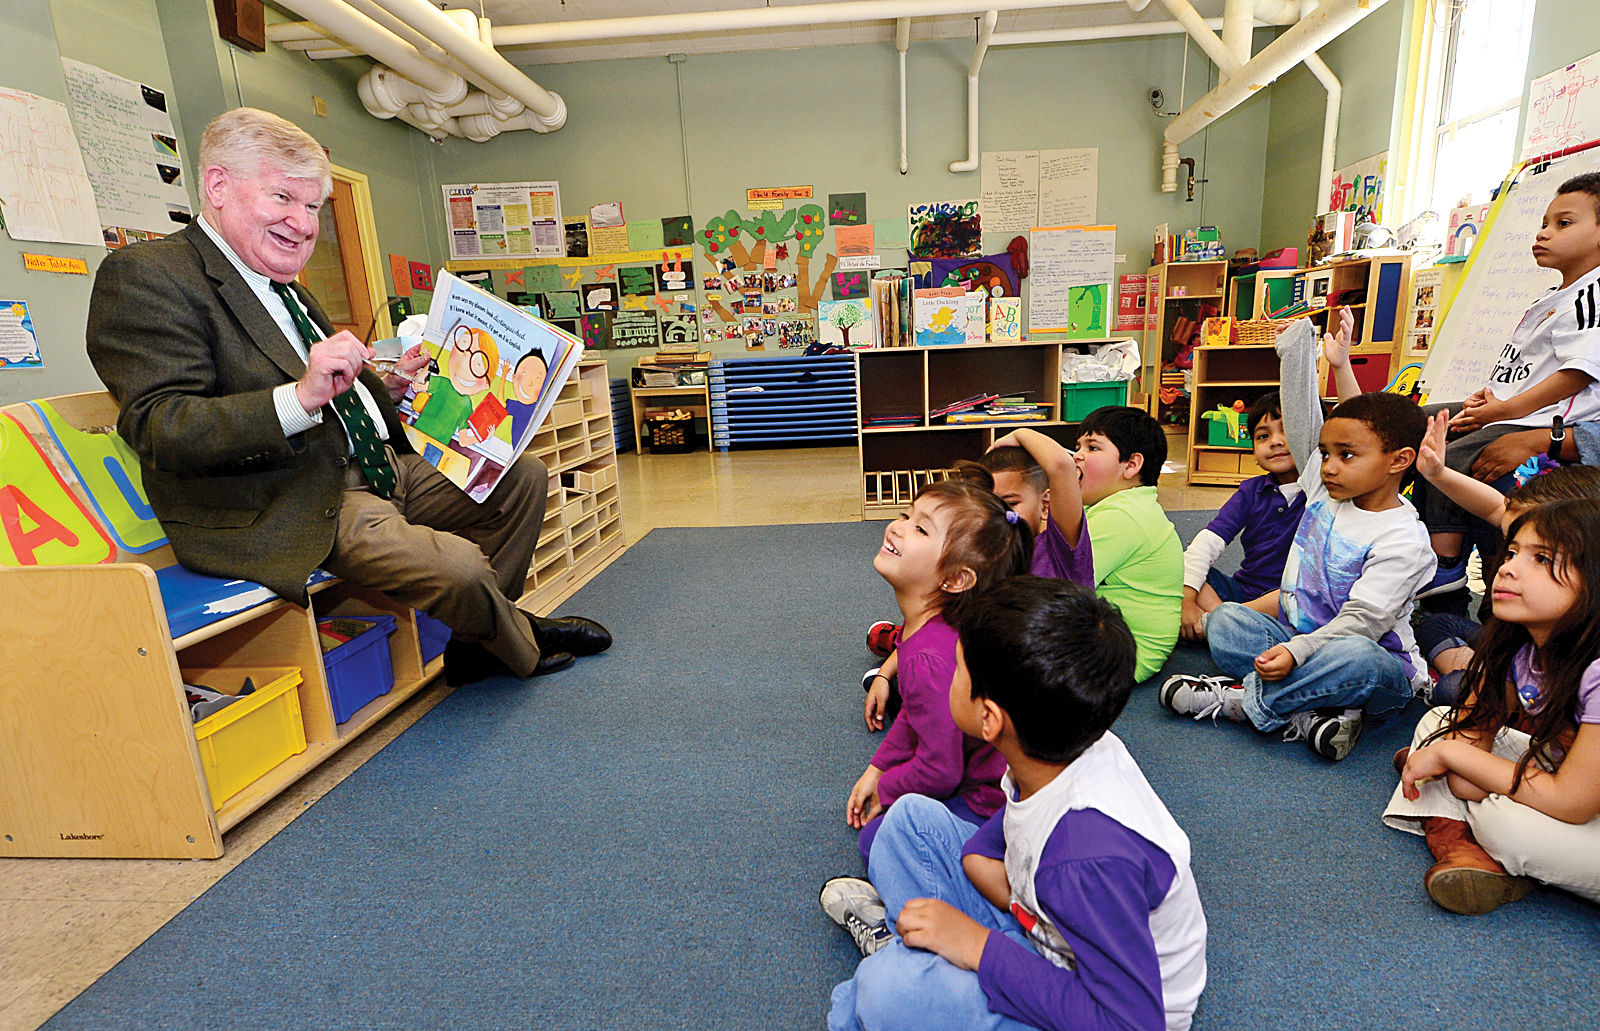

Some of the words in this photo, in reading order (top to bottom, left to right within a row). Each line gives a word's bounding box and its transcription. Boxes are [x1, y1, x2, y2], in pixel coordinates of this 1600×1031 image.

[47, 258, 68, 269] Table
[994, 304, 1006, 320] A
[1005, 306, 1016, 323] B
[1007, 322, 1018, 338] C
[60, 833, 103, 841] Lakeshore
